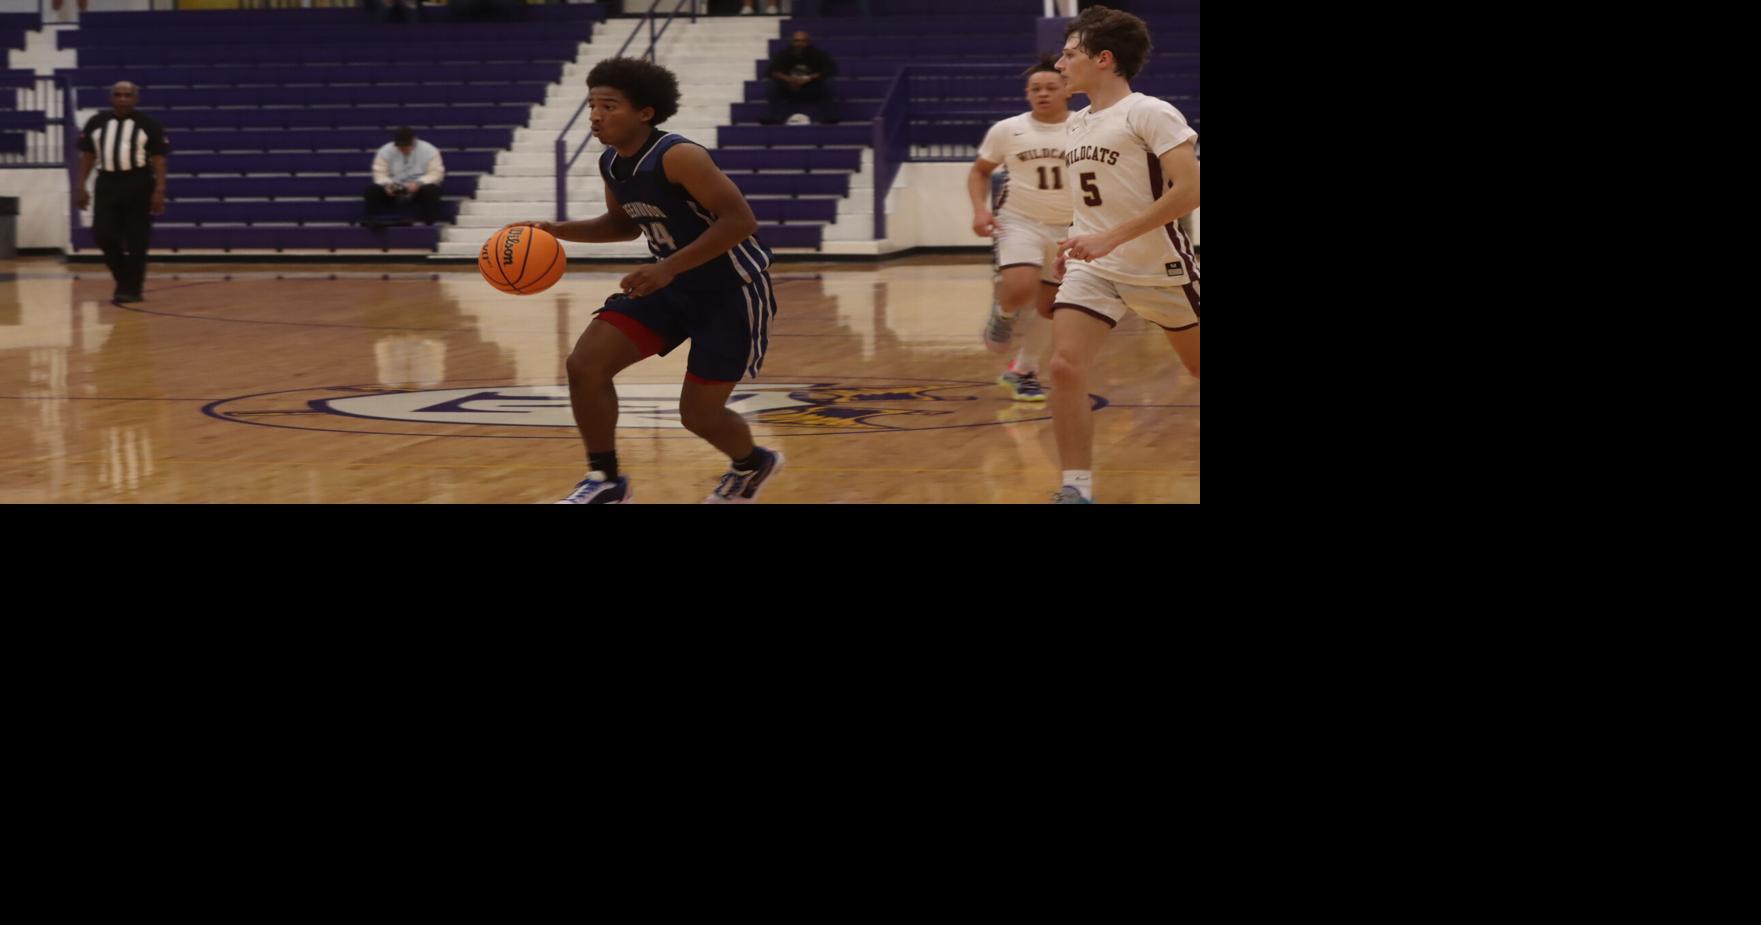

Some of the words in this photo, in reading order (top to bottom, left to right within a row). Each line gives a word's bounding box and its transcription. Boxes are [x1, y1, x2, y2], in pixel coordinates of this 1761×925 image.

[1017, 148, 1066, 162] WILDCA
[1037, 166, 1063, 190] 11
[1080, 171, 1103, 207] 5
[503, 227, 525, 266] Wilson
